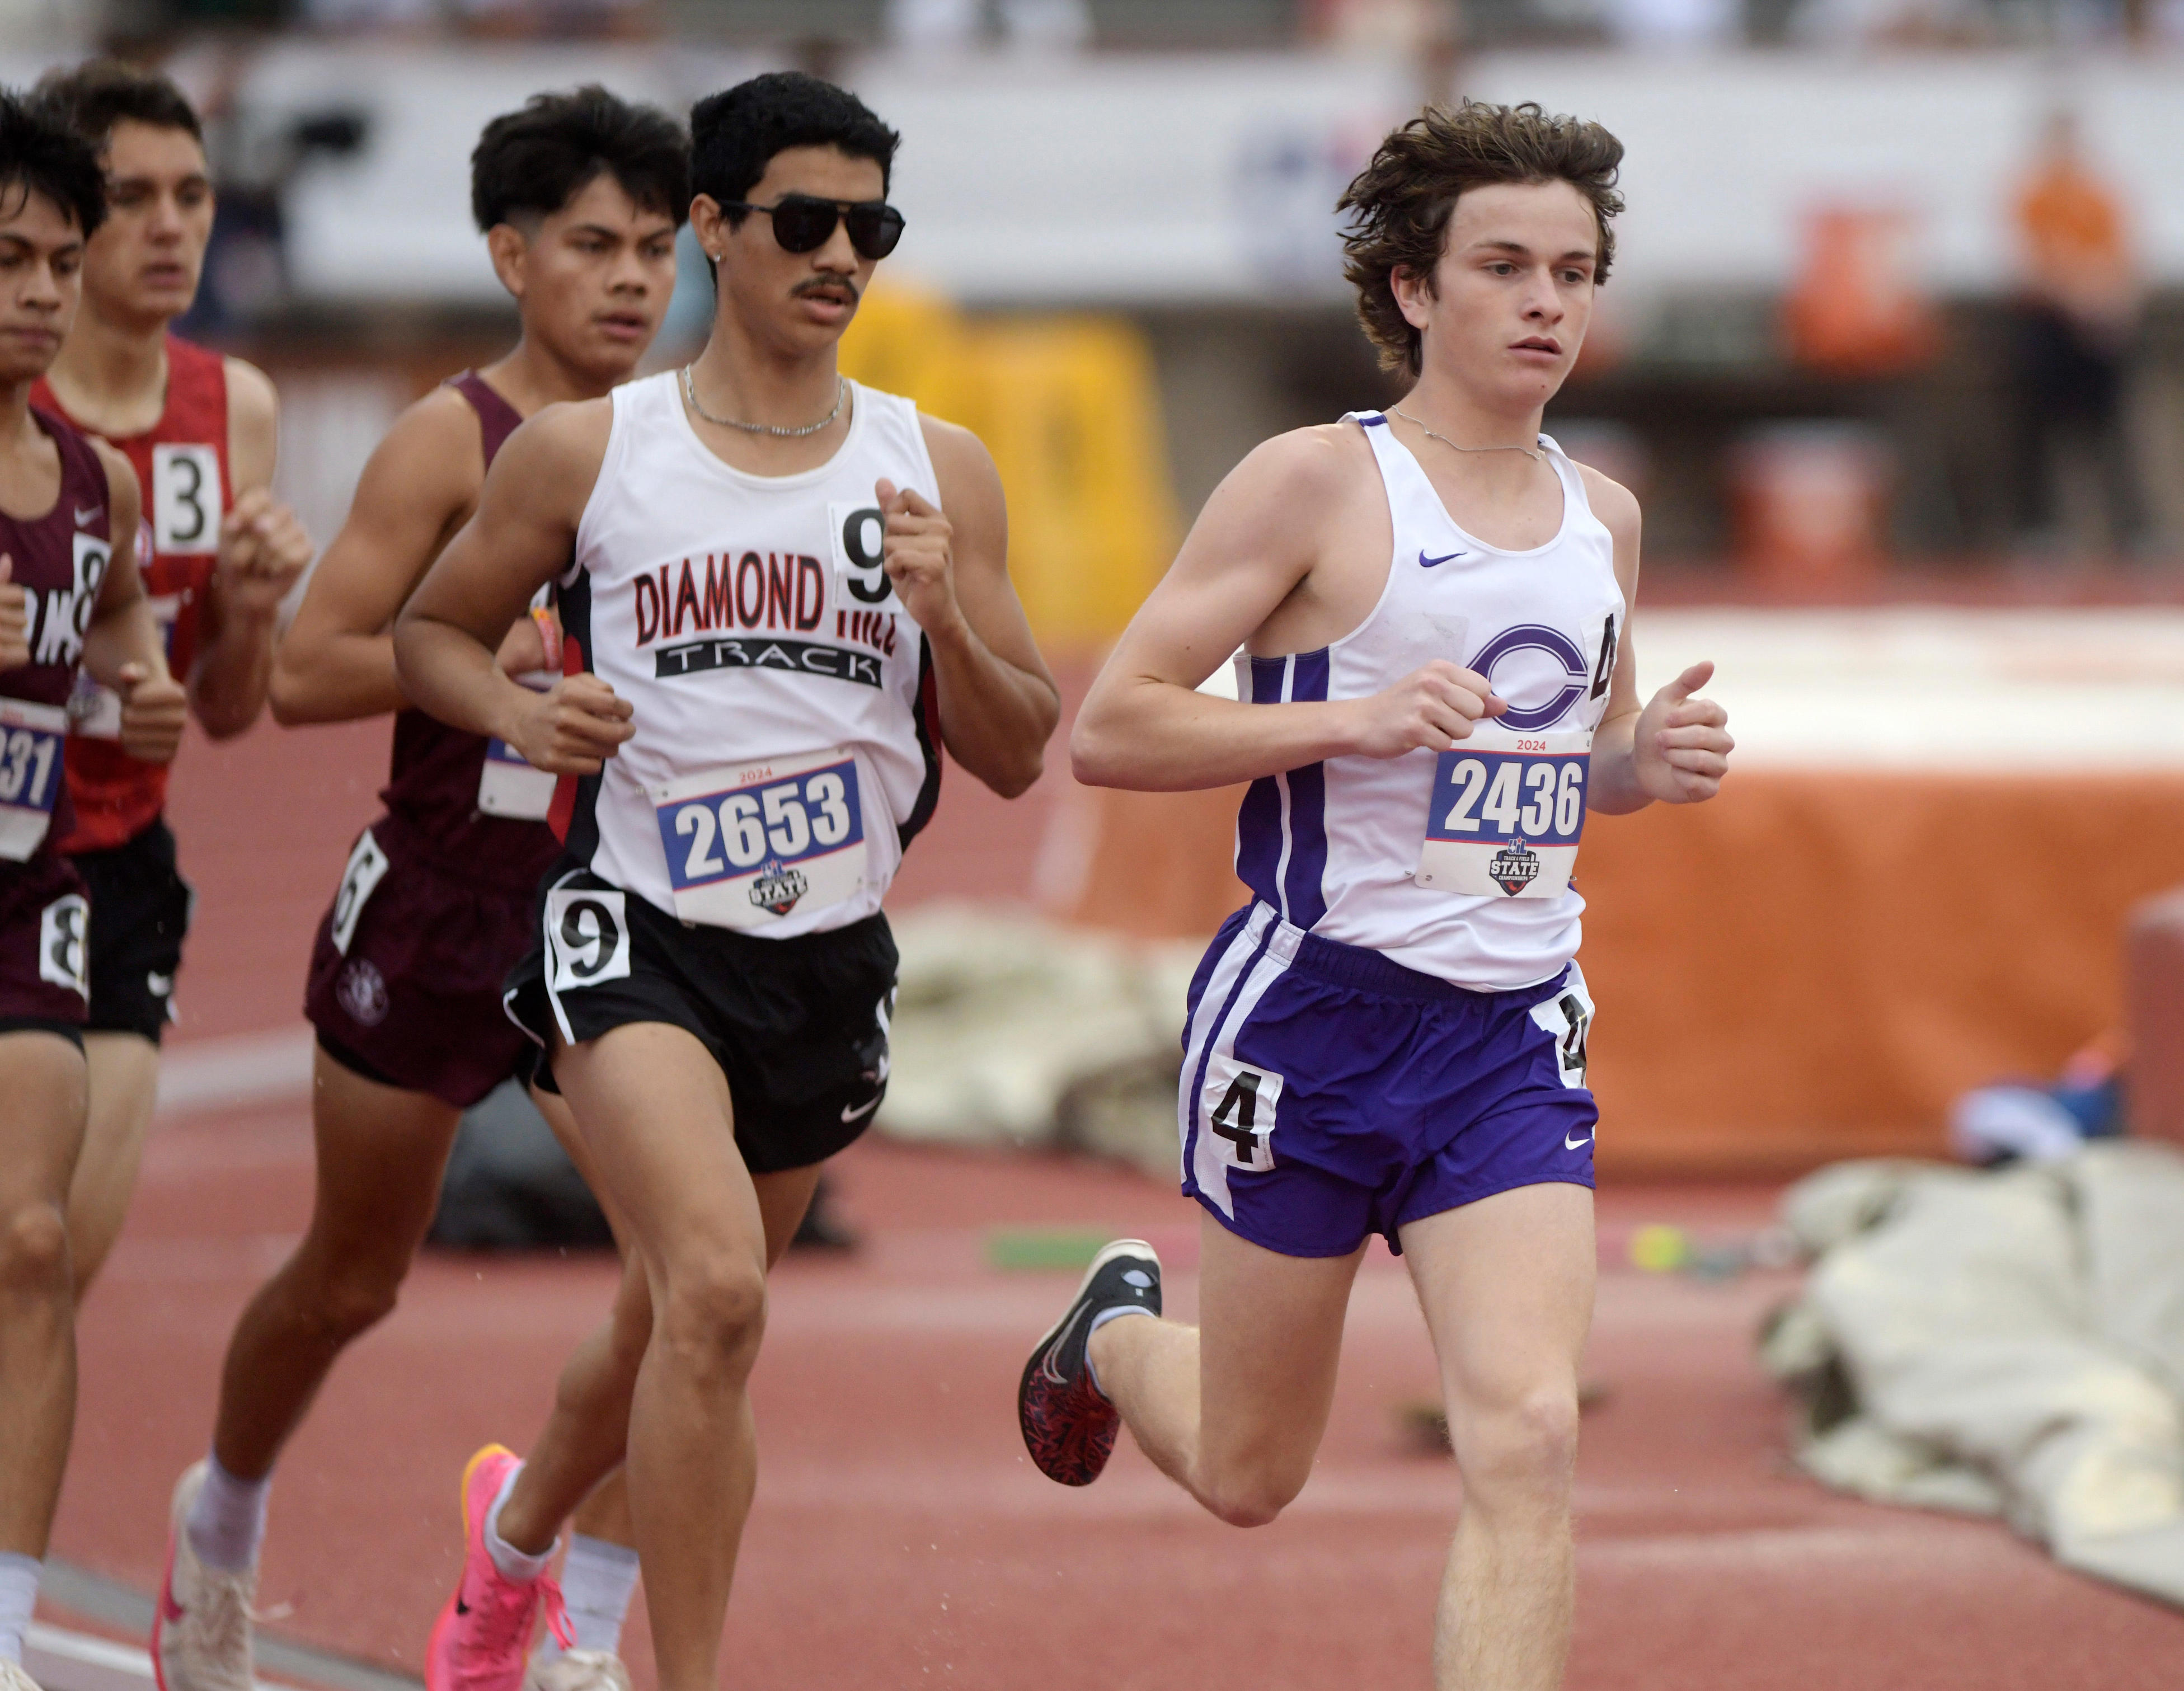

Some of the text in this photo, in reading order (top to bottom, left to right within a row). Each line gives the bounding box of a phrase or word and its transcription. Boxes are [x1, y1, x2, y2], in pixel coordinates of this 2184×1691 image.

[171, 457, 204, 542] 3
[73, 550, 105, 636] 8
[843, 509, 893, 603] 9
[633, 551, 825, 648] DIAMOND
[666, 641, 876, 682] TRACK
[1466, 624, 1588, 732] C
[0, 727, 55, 806] 31
[739, 766, 772, 783] 2024
[1517, 740, 1546, 751] 2024
[675, 772, 851, 880] 2653
[1444, 758, 1582, 836] 2436
[335, 852, 374, 933] 6
[1490, 861, 1539, 876] STATE
[561, 899, 619, 978] 9
[1558, 993, 1587, 1087] 4
[1211, 1070, 1262, 1164] 4
